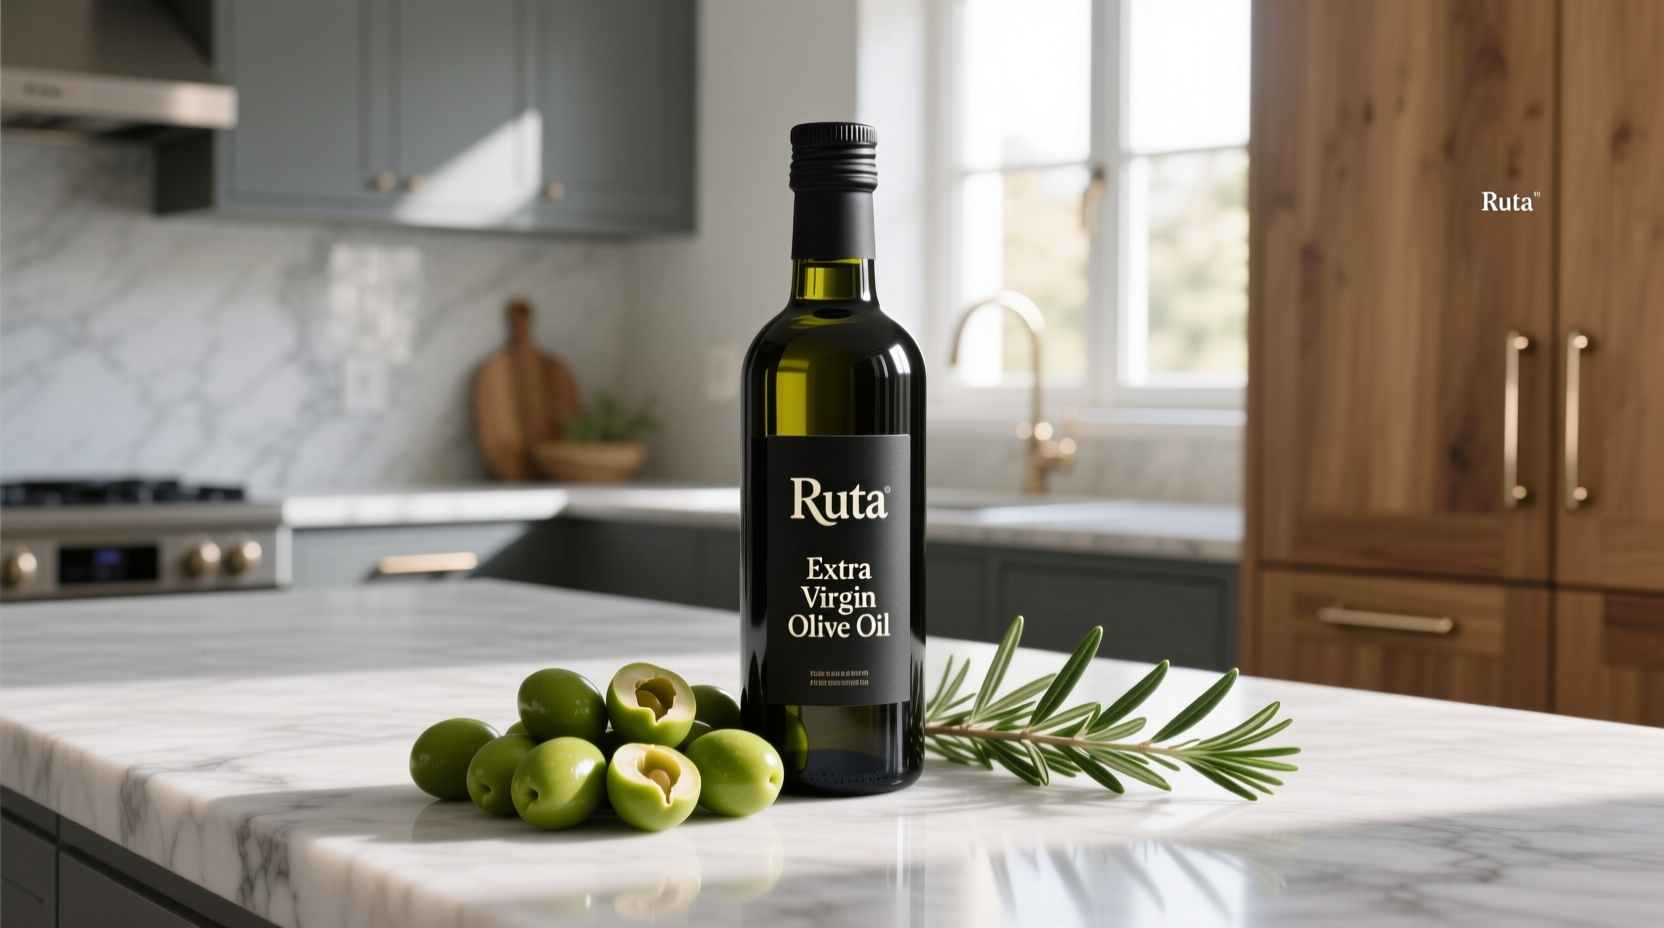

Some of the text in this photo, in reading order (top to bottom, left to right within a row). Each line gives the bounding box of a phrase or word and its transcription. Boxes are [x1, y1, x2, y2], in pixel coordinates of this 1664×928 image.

[790, 477, 889, 527] Ruta
[806, 556, 872, 580] Extra
[800, 586, 877, 616] Virgin
[788, 612, 891, 638] Olive Oil
